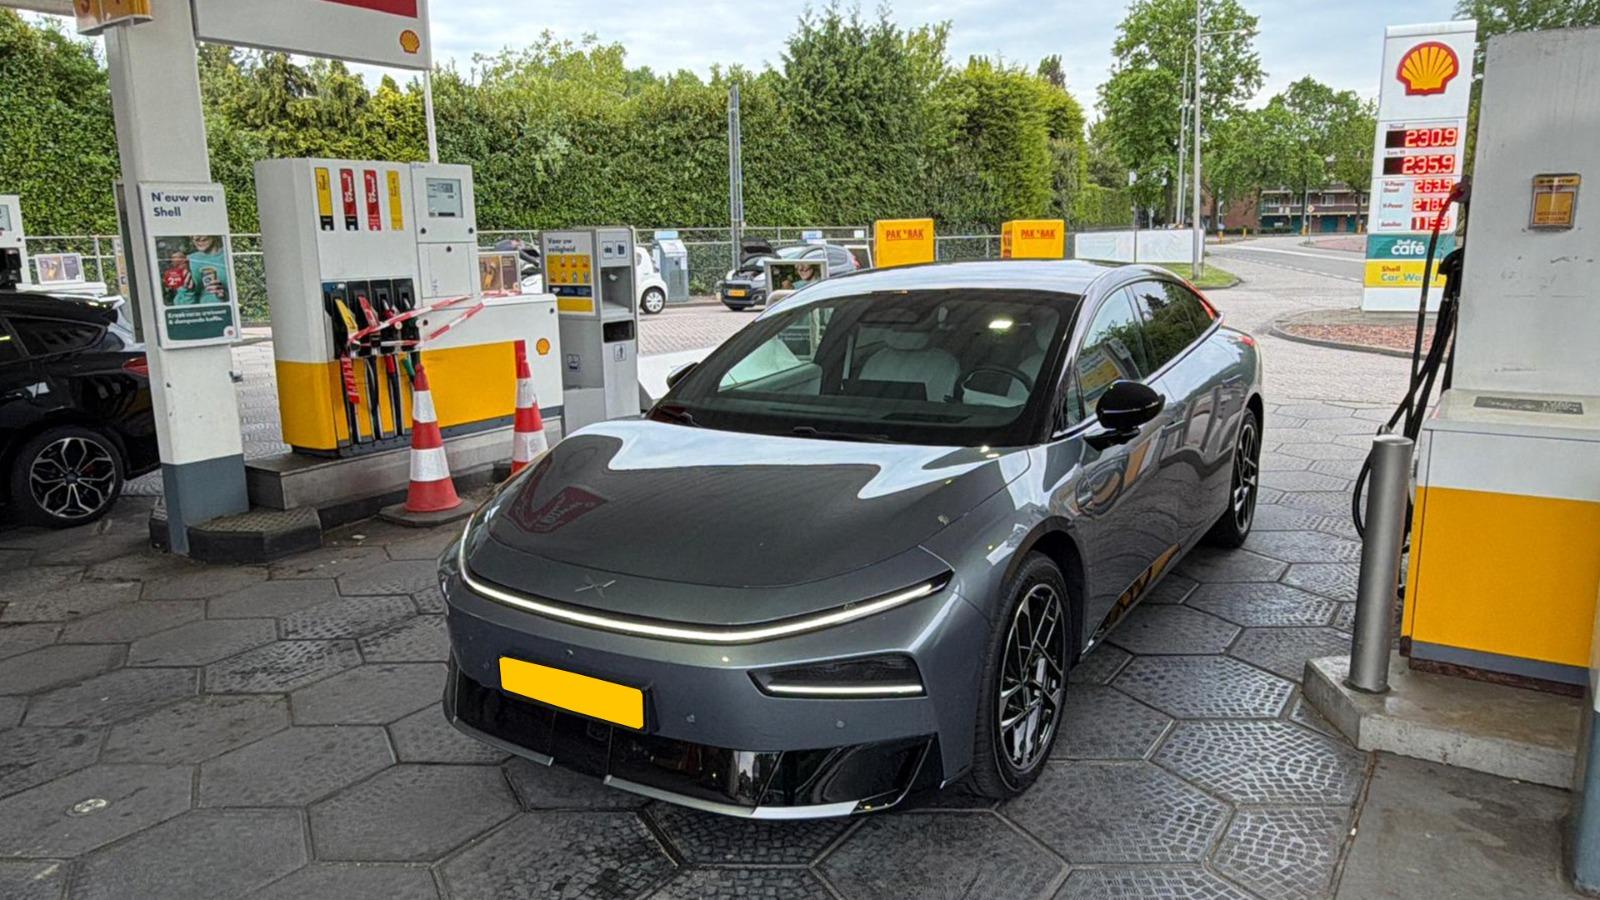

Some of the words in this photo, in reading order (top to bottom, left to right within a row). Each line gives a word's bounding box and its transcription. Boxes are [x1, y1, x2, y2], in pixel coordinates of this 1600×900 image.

[1405, 128, 1457, 147] 230.9
[1402, 155, 1455, 174] 235.9
[1414, 179, 1453, 193] 263.9
[193, 195, 214, 203] van
[153, 207, 182, 217] Shell
[1391, 241, 1425, 255] café
[1381, 273, 1398, 281] Car
